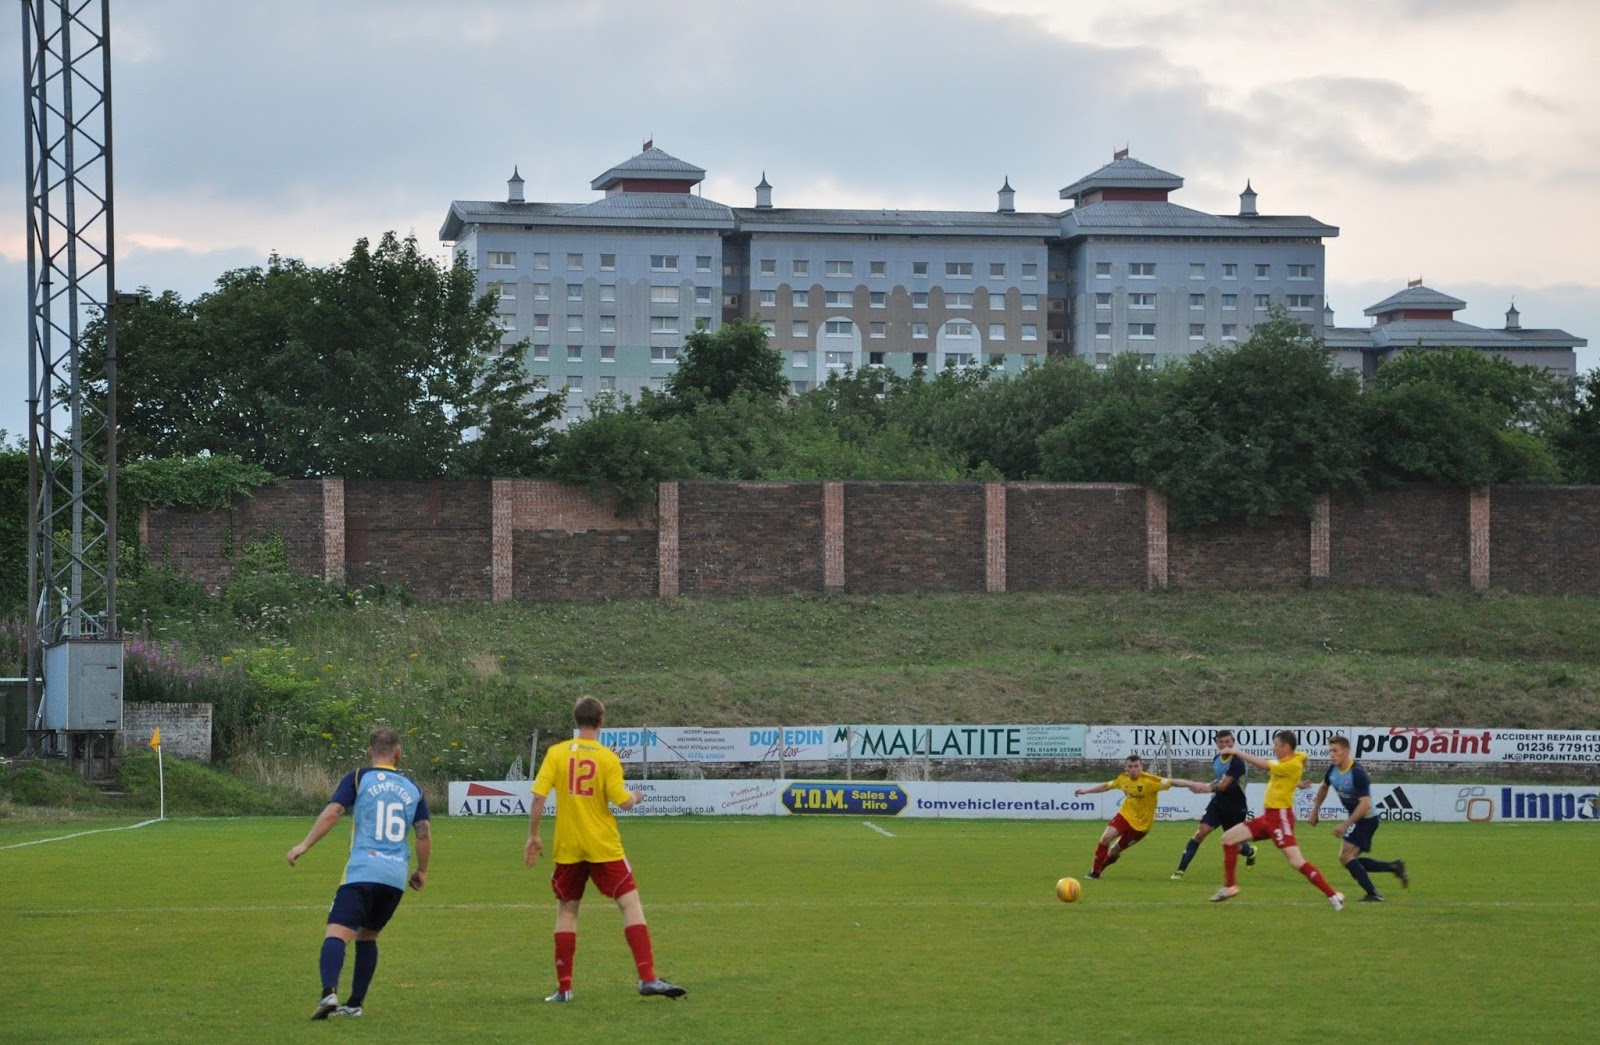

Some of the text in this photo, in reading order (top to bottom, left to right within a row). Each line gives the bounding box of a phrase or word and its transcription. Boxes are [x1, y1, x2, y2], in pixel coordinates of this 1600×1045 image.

[860, 728, 1021, 756] MALLATITE
[1130, 729, 1218, 746] TRAINOR
[1355, 730, 1492, 759] propaint
[1495, 733, 1544, 741] ACCIDENT
[1549, 734, 1582, 742] REPAIR
[1517, 742, 1554, 752] 01236
[568, 757, 596, 797] 12
[367, 781, 414, 806] TEMPLETON
[642, 794, 686, 803] Contractors
[791, 789, 848, 809] T.O.M.
[852, 790, 898, 800] Sales &
[460, 798, 527, 815] AILSA
[862, 800, 888, 810] Hire
[917, 797, 1095, 811] tomvehiclerental.com
[375, 800, 406, 842] 16
[1273, 828, 1284, 841] 3
